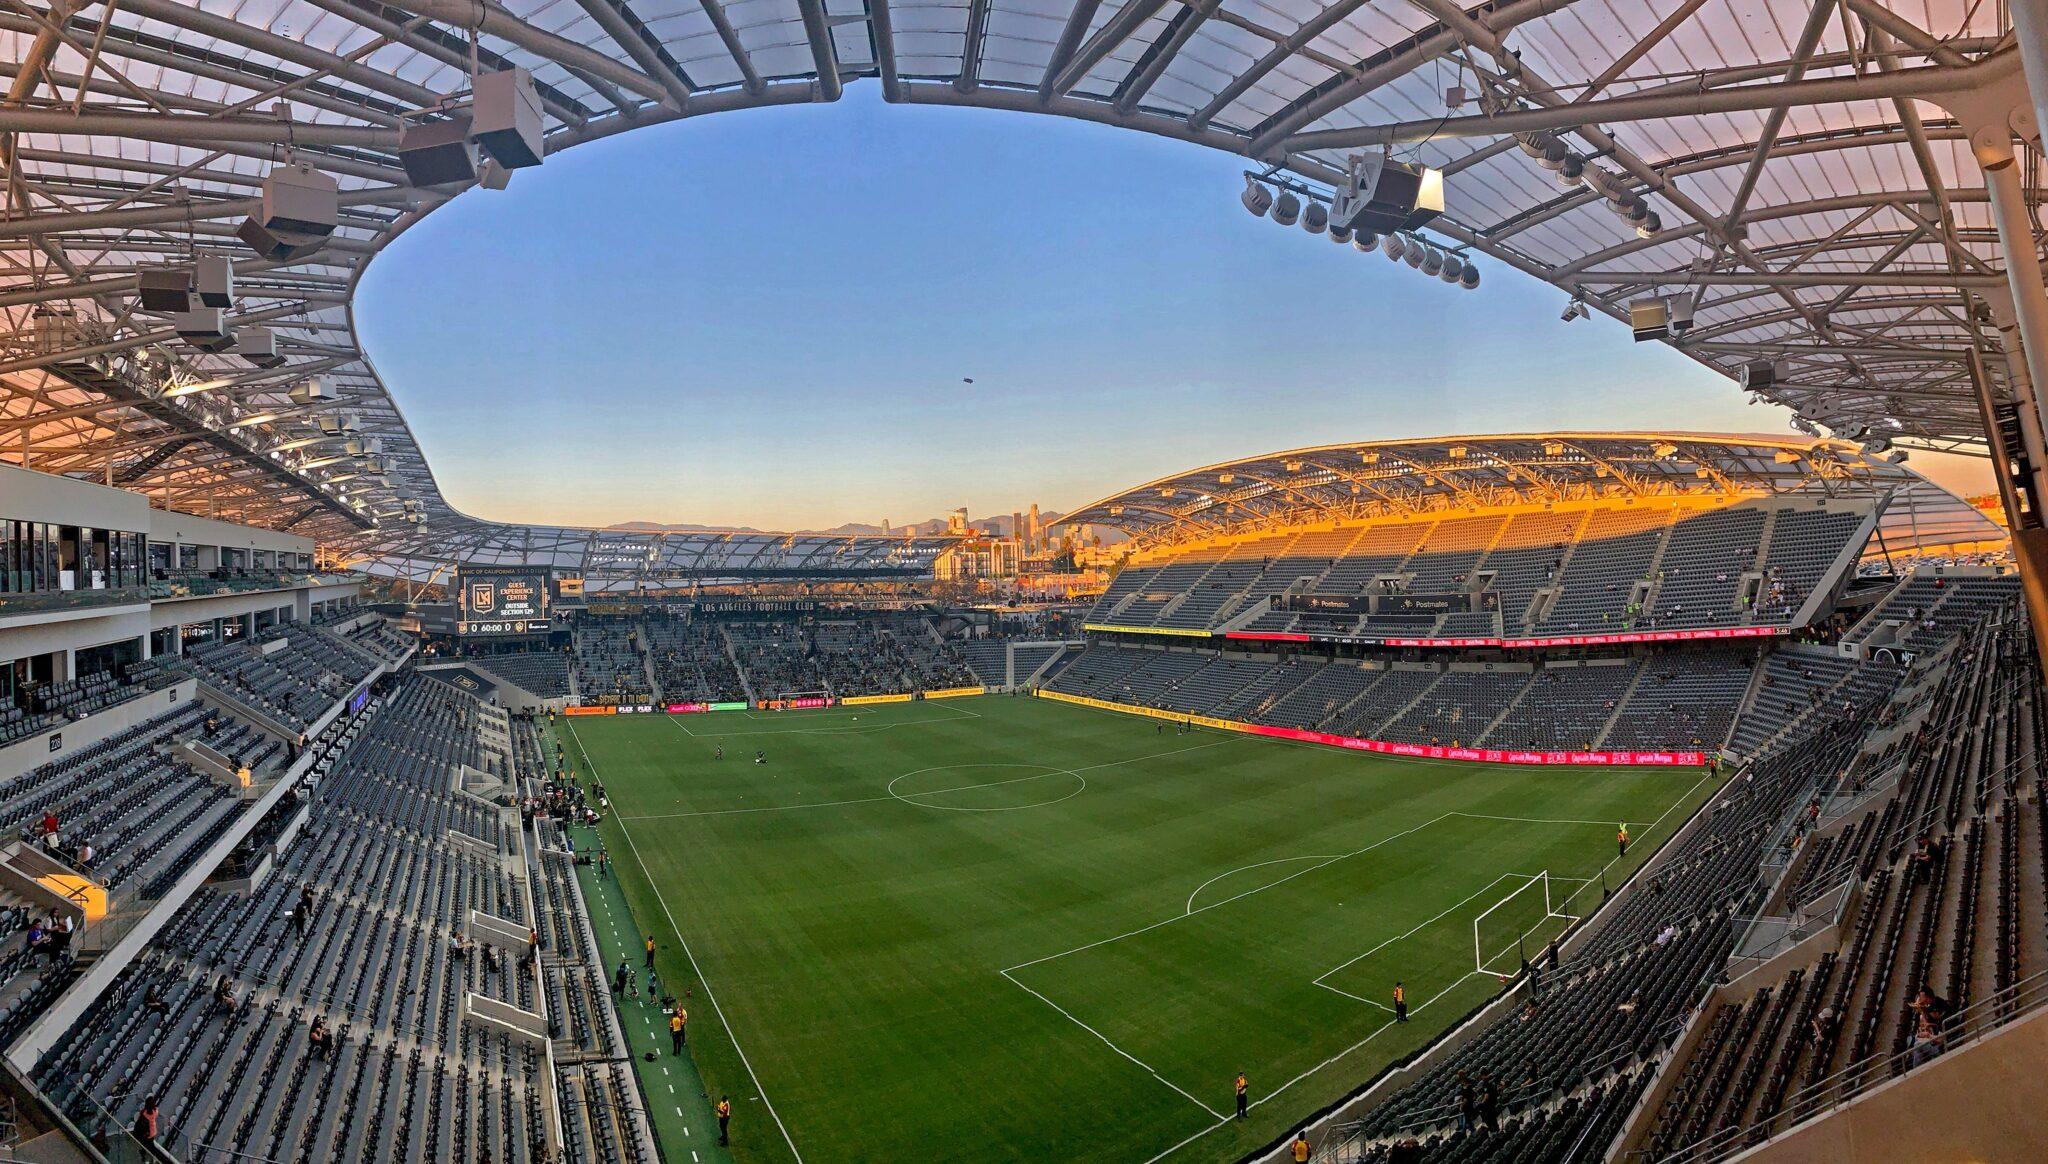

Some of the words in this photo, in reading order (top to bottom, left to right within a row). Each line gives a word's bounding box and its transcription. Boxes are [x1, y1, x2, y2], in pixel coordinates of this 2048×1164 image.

[701, 603, 716, 612] LOS
[719, 602, 752, 611] ANGELES
[756, 602, 792, 612] FOOTBALL
[796, 602, 814, 610] CLUB
[471, 624, 478, 632] 0
[481, 624, 502, 632] 60:00
[505, 623, 511, 631] 0
[1448, 750, 1463, 759] Captain
[1462, 750, 1480, 760] Morgan
[1509, 752, 1525, 762] Captain
[1524, 752, 1542, 764] Morgan
[1572, 753, 1590, 763] Captain
[1588, 753, 1607, 763] Morgan
[1636, 754, 1654, 764] Captain
[1653, 753, 1672, 764] Morgan
[112, 984, 122, 1006] 127
